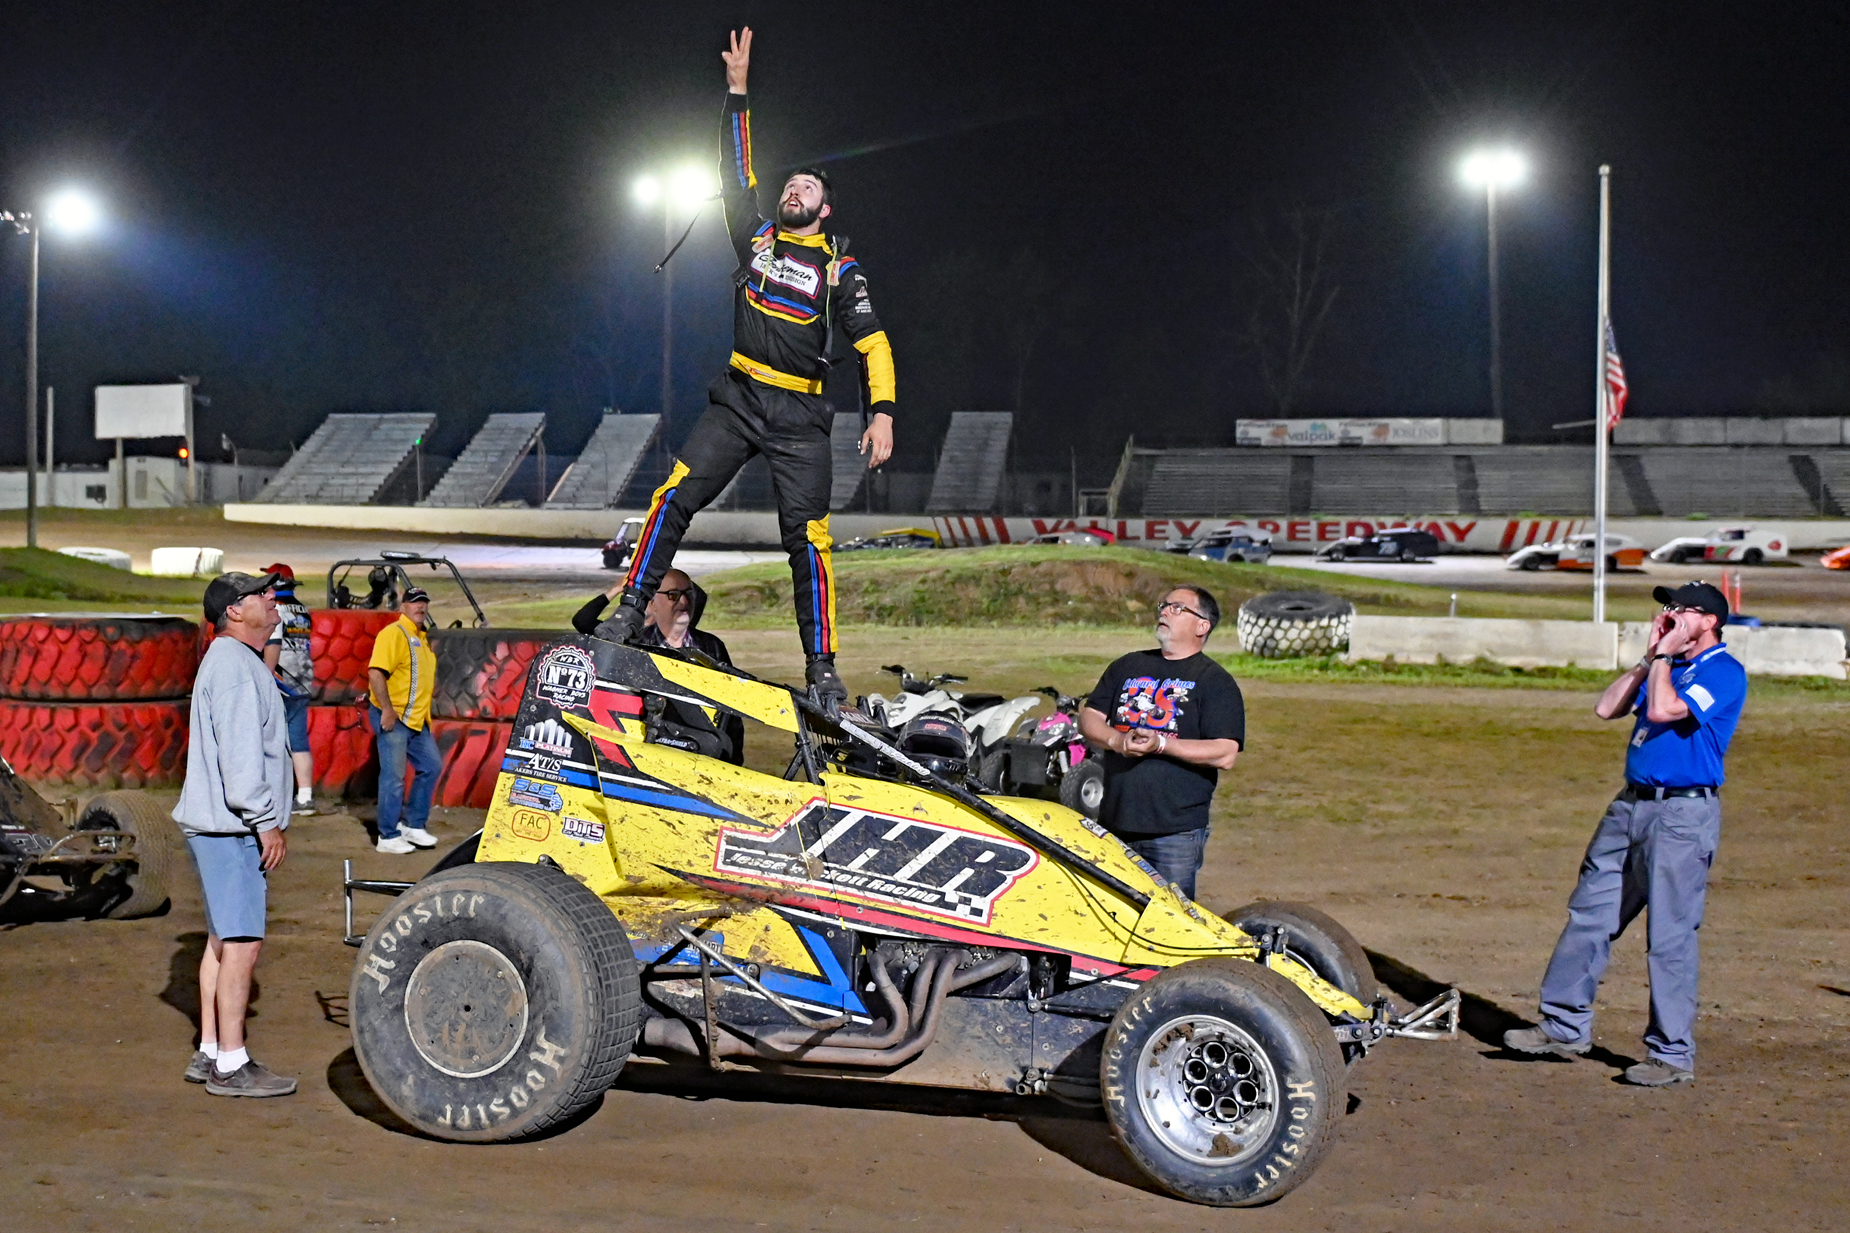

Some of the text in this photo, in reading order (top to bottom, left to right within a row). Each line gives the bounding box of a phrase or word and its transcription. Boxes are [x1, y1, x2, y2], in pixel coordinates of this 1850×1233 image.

[1225, 520, 1476, 543] PEEDAY
[552, 692, 576, 702] RACING
[533, 769, 546, 778] TIRE
[545, 772, 568, 783] SERVICE
[520, 813, 543, 830] FAC
[726, 852, 942, 903] Jesse Hkett Racing
